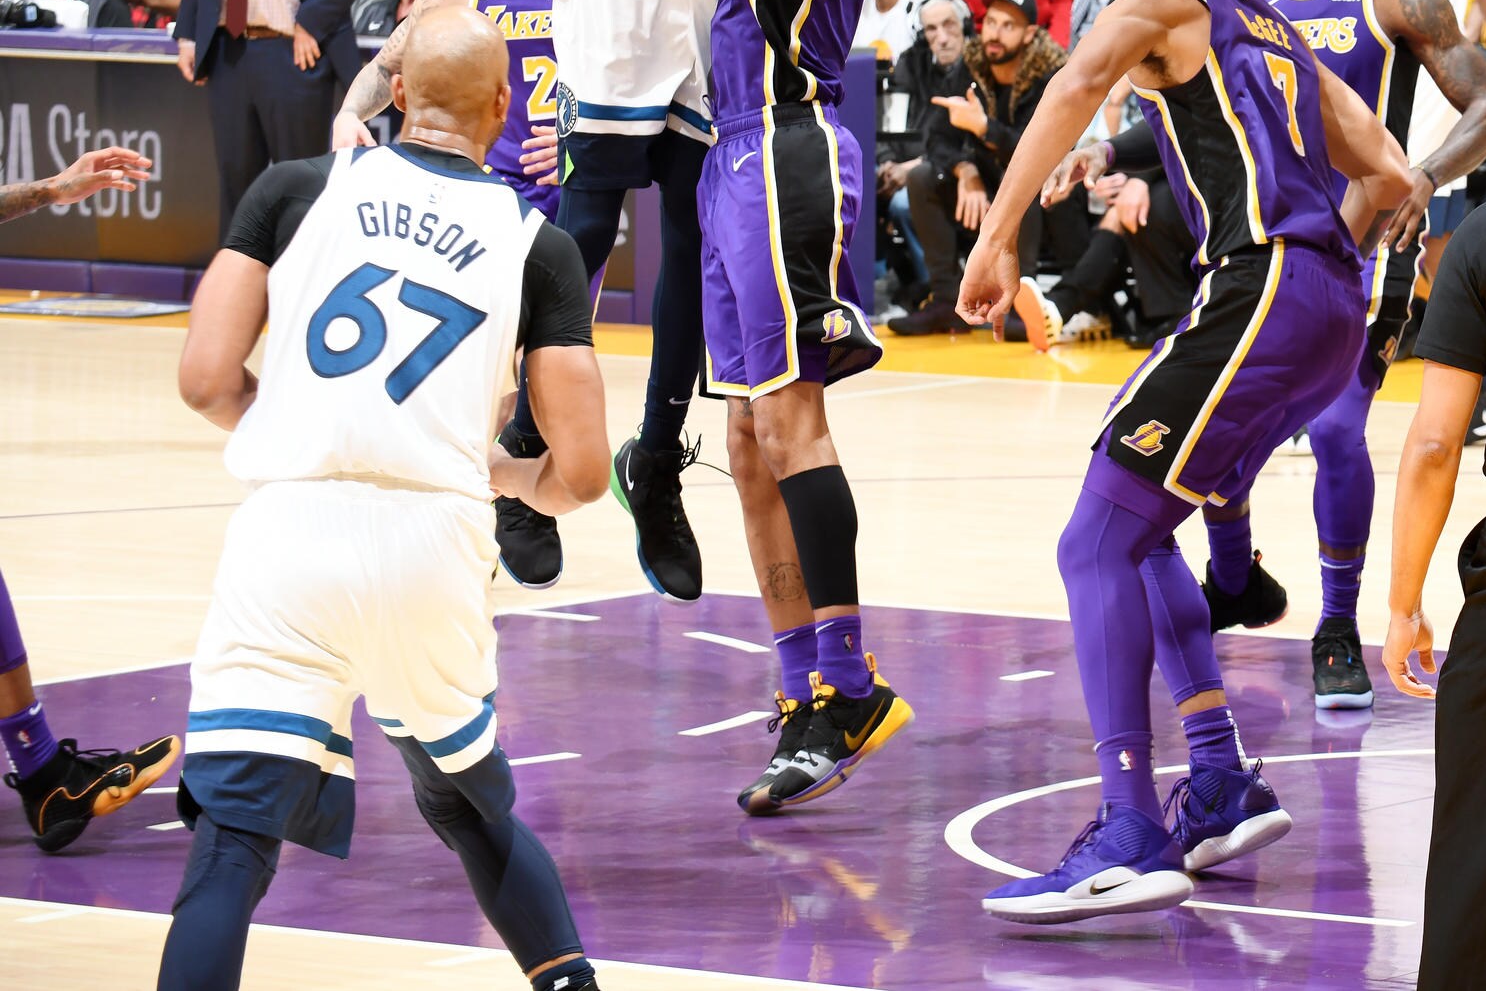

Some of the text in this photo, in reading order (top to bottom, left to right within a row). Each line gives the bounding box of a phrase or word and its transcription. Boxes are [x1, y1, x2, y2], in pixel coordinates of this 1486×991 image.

[484, 5, 553, 41] LAKE
[1291, 17, 1358, 54] ERS
[1262, 50, 1305, 157] 7
[356, 200, 487, 273] GIBSON
[306, 261, 489, 406] 67
